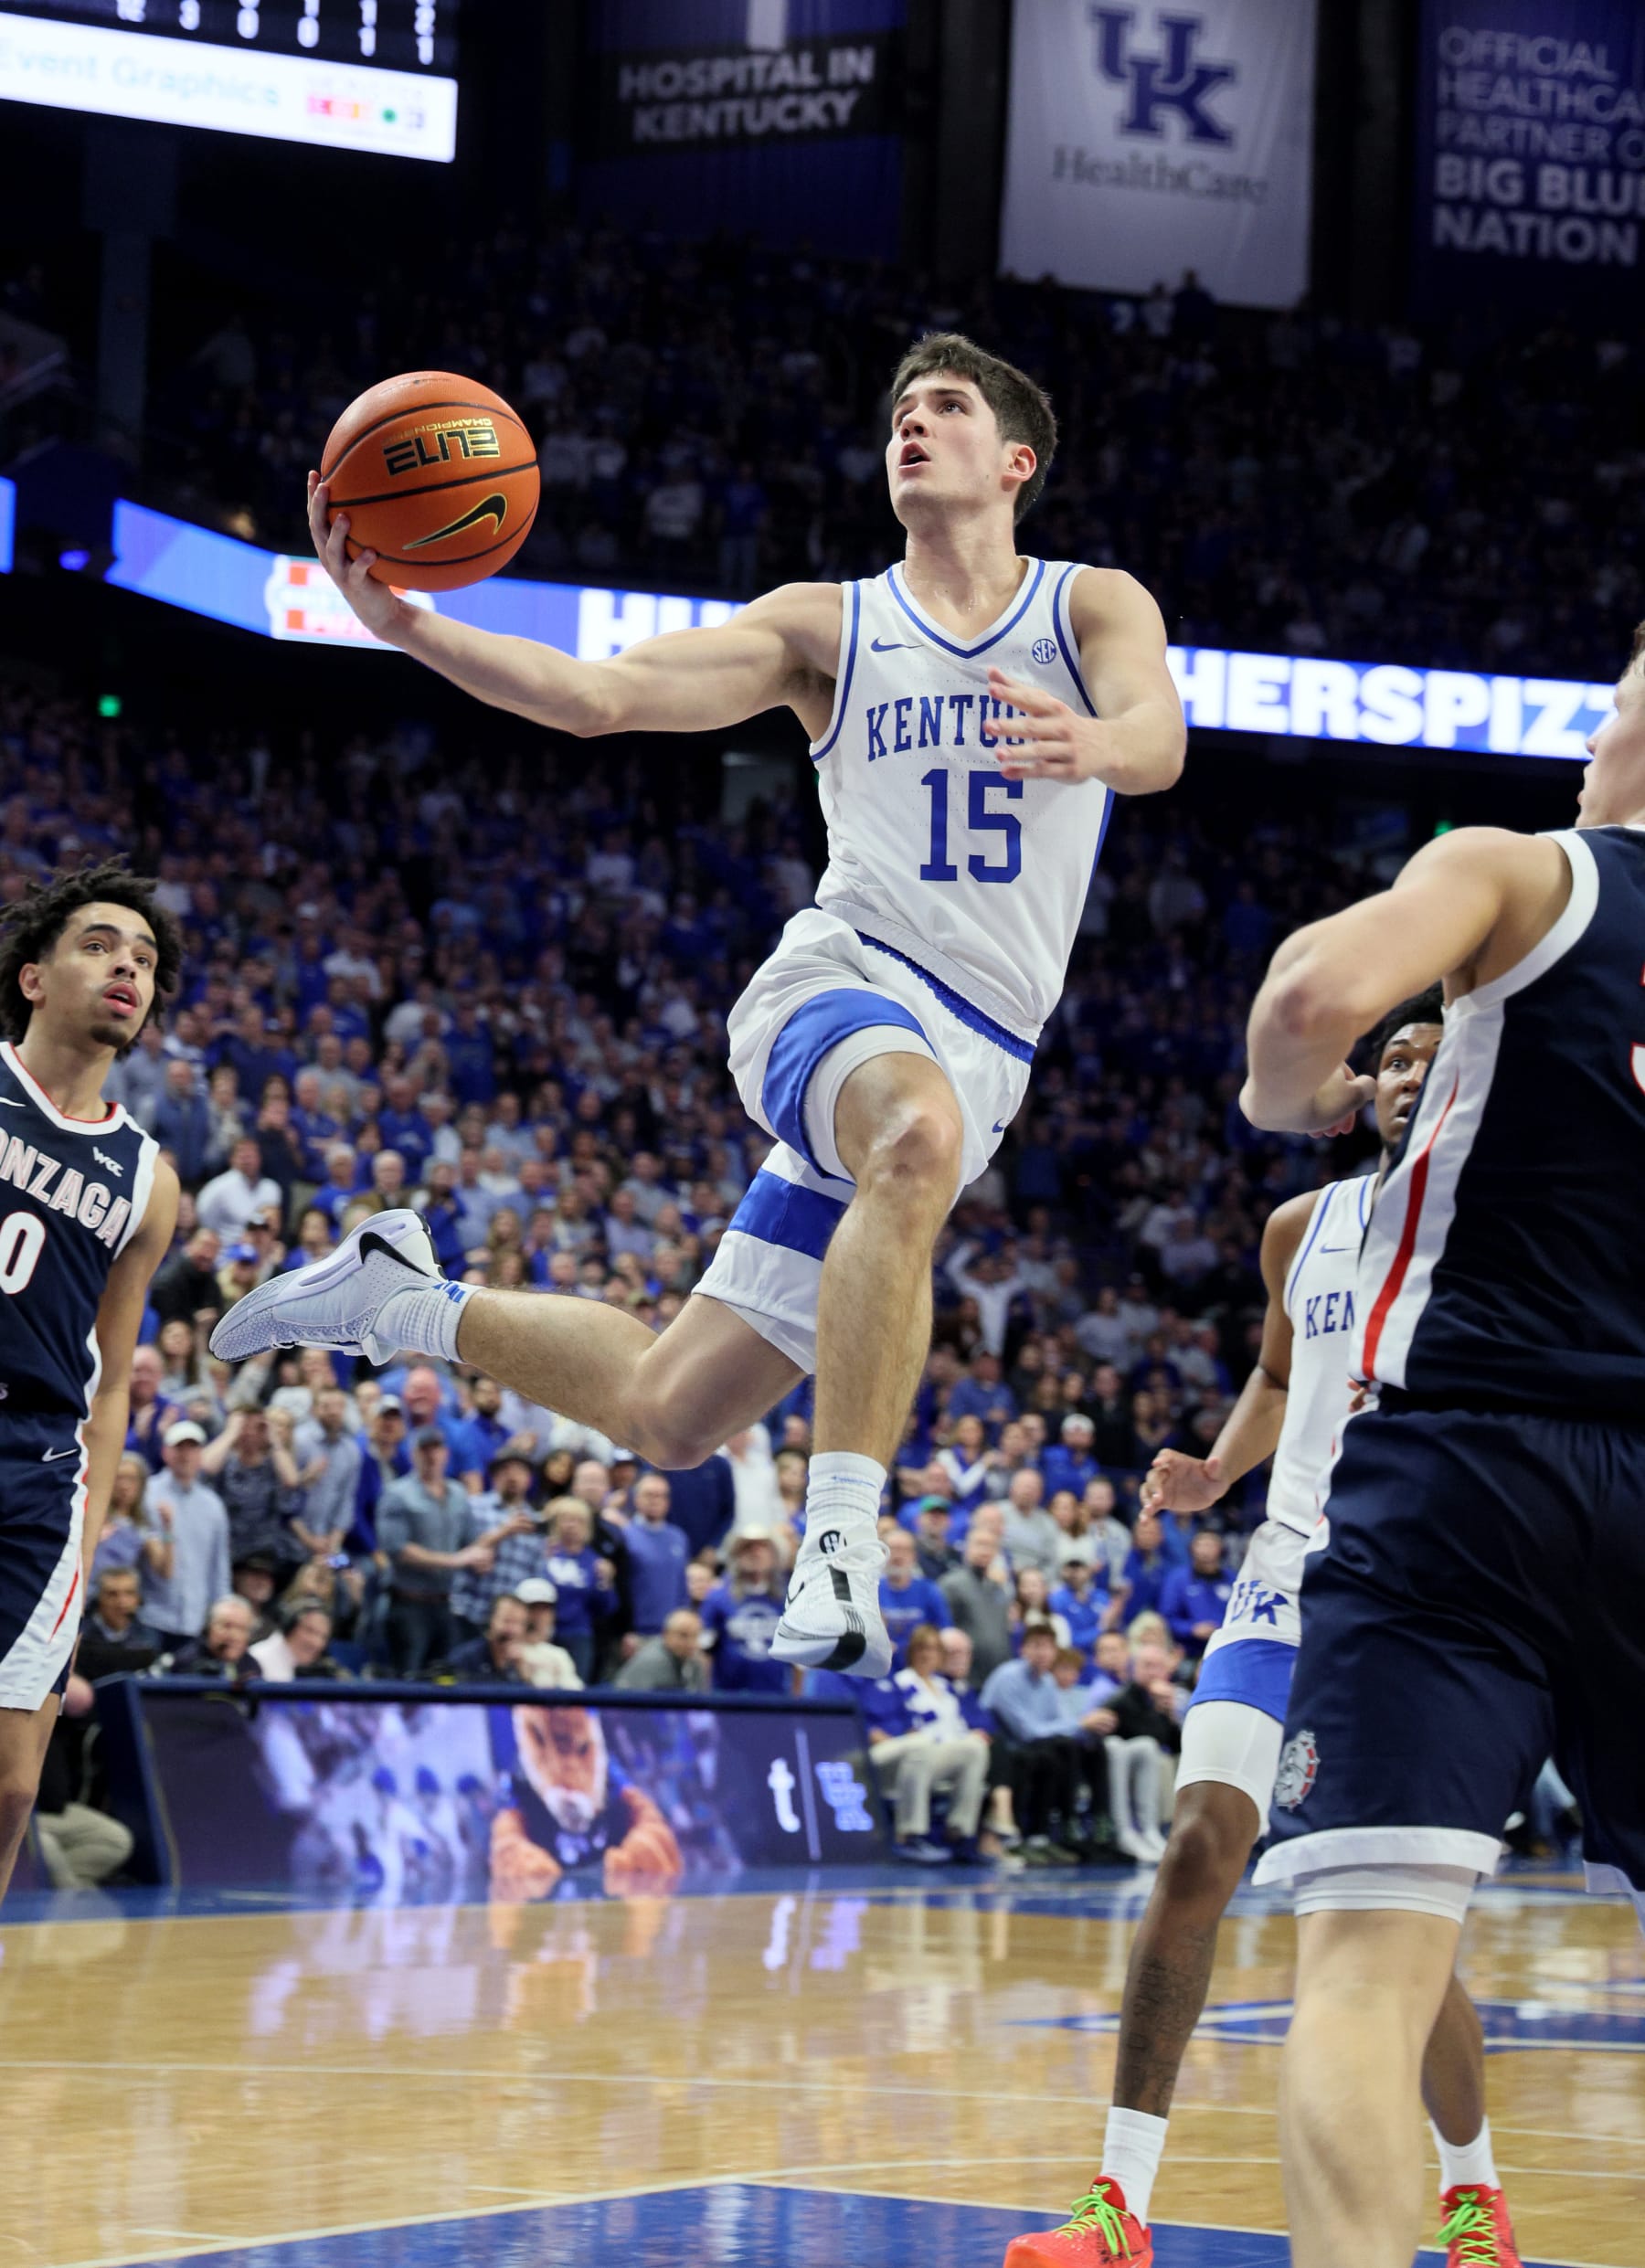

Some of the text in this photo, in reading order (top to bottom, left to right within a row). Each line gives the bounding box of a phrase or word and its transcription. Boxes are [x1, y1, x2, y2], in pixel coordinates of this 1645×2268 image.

[111, 53, 281, 109] Graphics
[618, 46, 876, 101] HOSPITAL IN
[1089, 5, 1236, 149] UK
[1438, 26, 1617, 82] OFFICIAL
[632, 90, 860, 142] KENTUCKY
[1435, 69, 1645, 125] HEALTHCA
[1434, 109, 1611, 164] PARTNER
[1052, 143, 1268, 205] HealthCare
[1434, 152, 1645, 219] BIG BLU
[1431, 203, 1639, 268] NATION
[382, 426, 501, 476] ELITE
[1033, 641, 1056, 663] SEC
[920, 768, 1024, 884] 15
[92, 1146, 124, 1178] WCC
